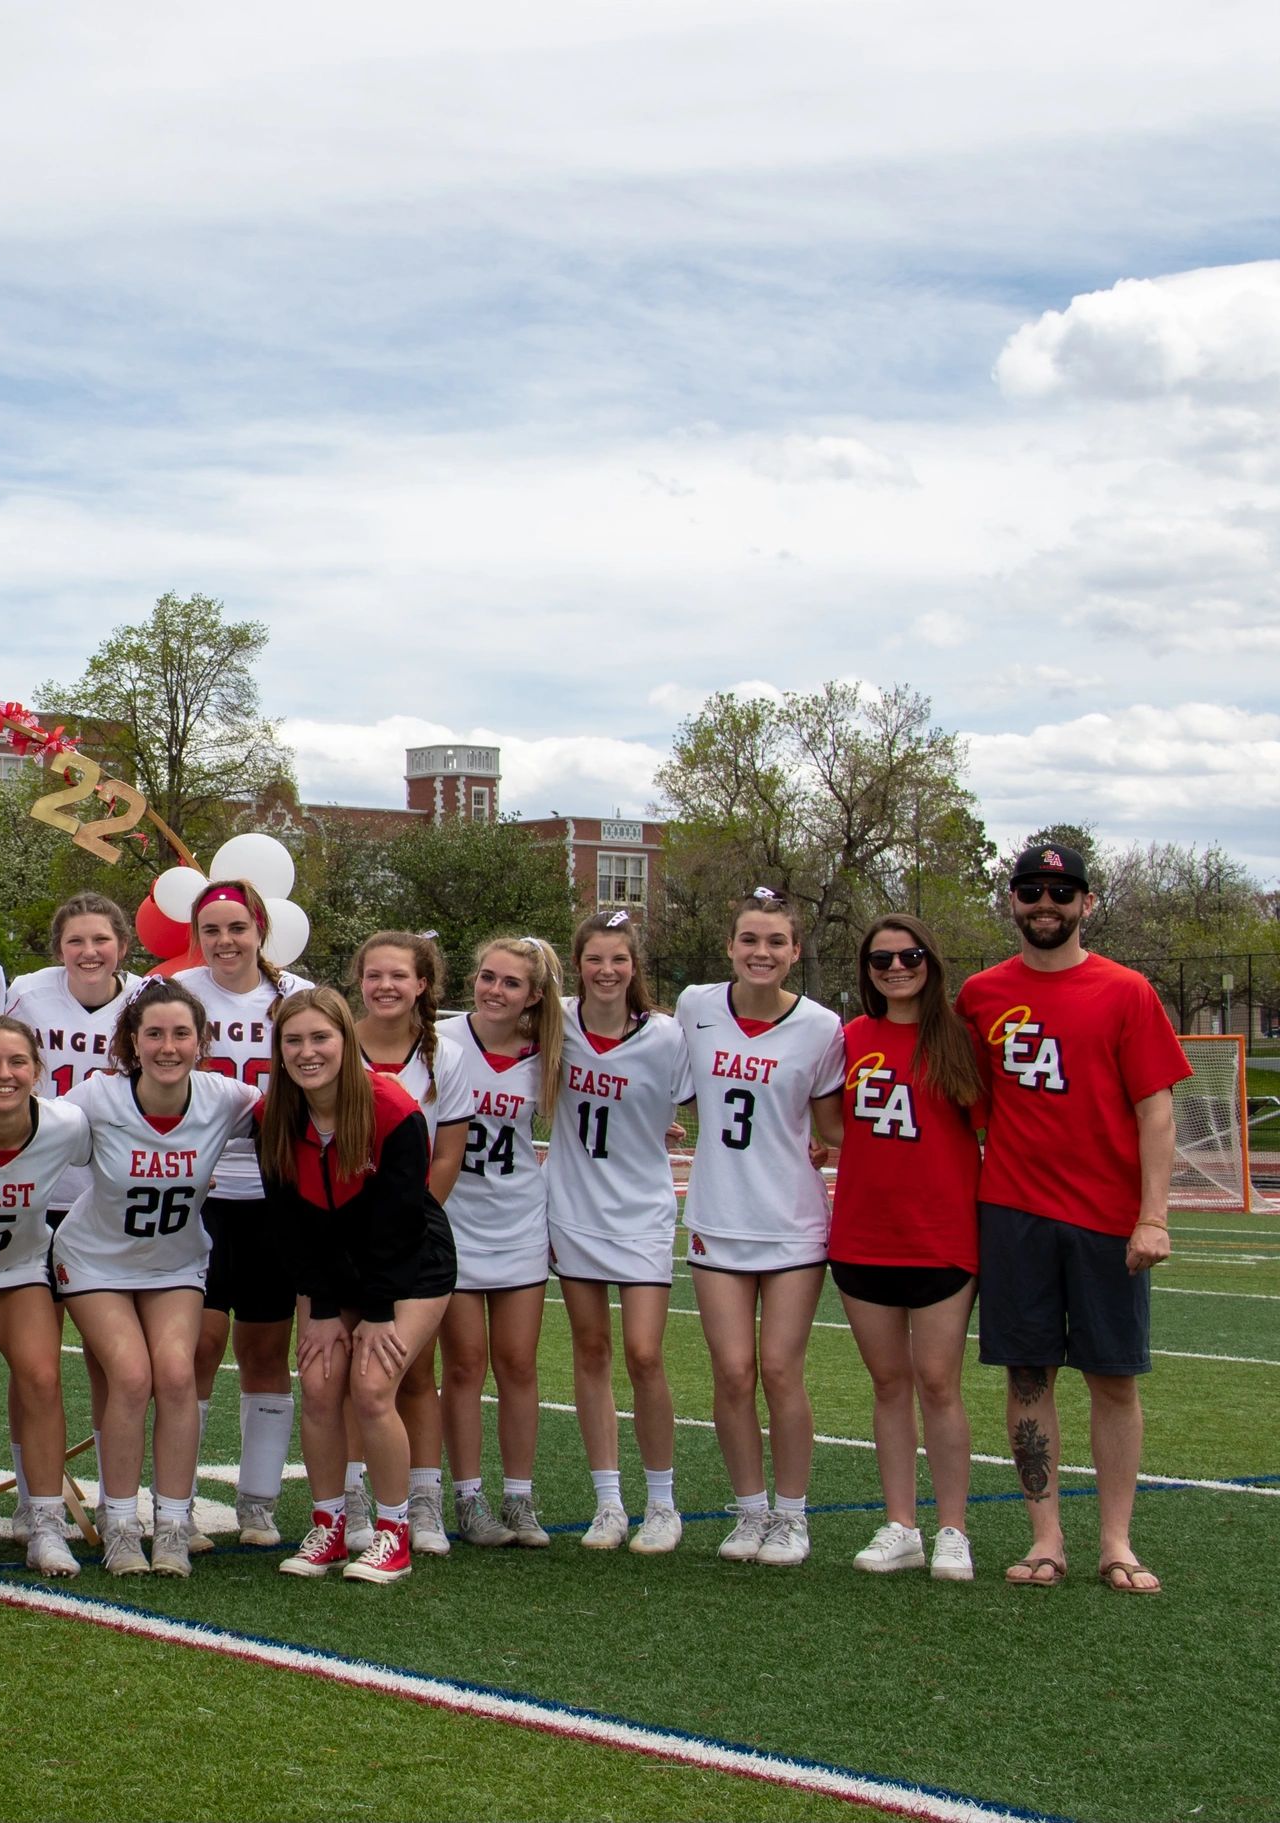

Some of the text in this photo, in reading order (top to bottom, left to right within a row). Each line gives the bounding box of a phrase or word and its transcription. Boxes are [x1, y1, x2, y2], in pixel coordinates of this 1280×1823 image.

[30, 751, 147, 865] 22
[34, 1028, 107, 1054] ANGE
[206, 1021, 264, 1042] NGE
[1003, 1023, 1065, 1090] EA
[569, 1066, 628, 1101] EAST
[711, 1051, 778, 1084] EAST
[721, 1088, 755, 1150] 3
[854, 1068, 917, 1138] EA
[461, 1122, 515, 1177] 24
[577, 1101, 609, 1159] 11
[130, 1150, 197, 1178] EAST
[124, 1186, 196, 1238] 26
